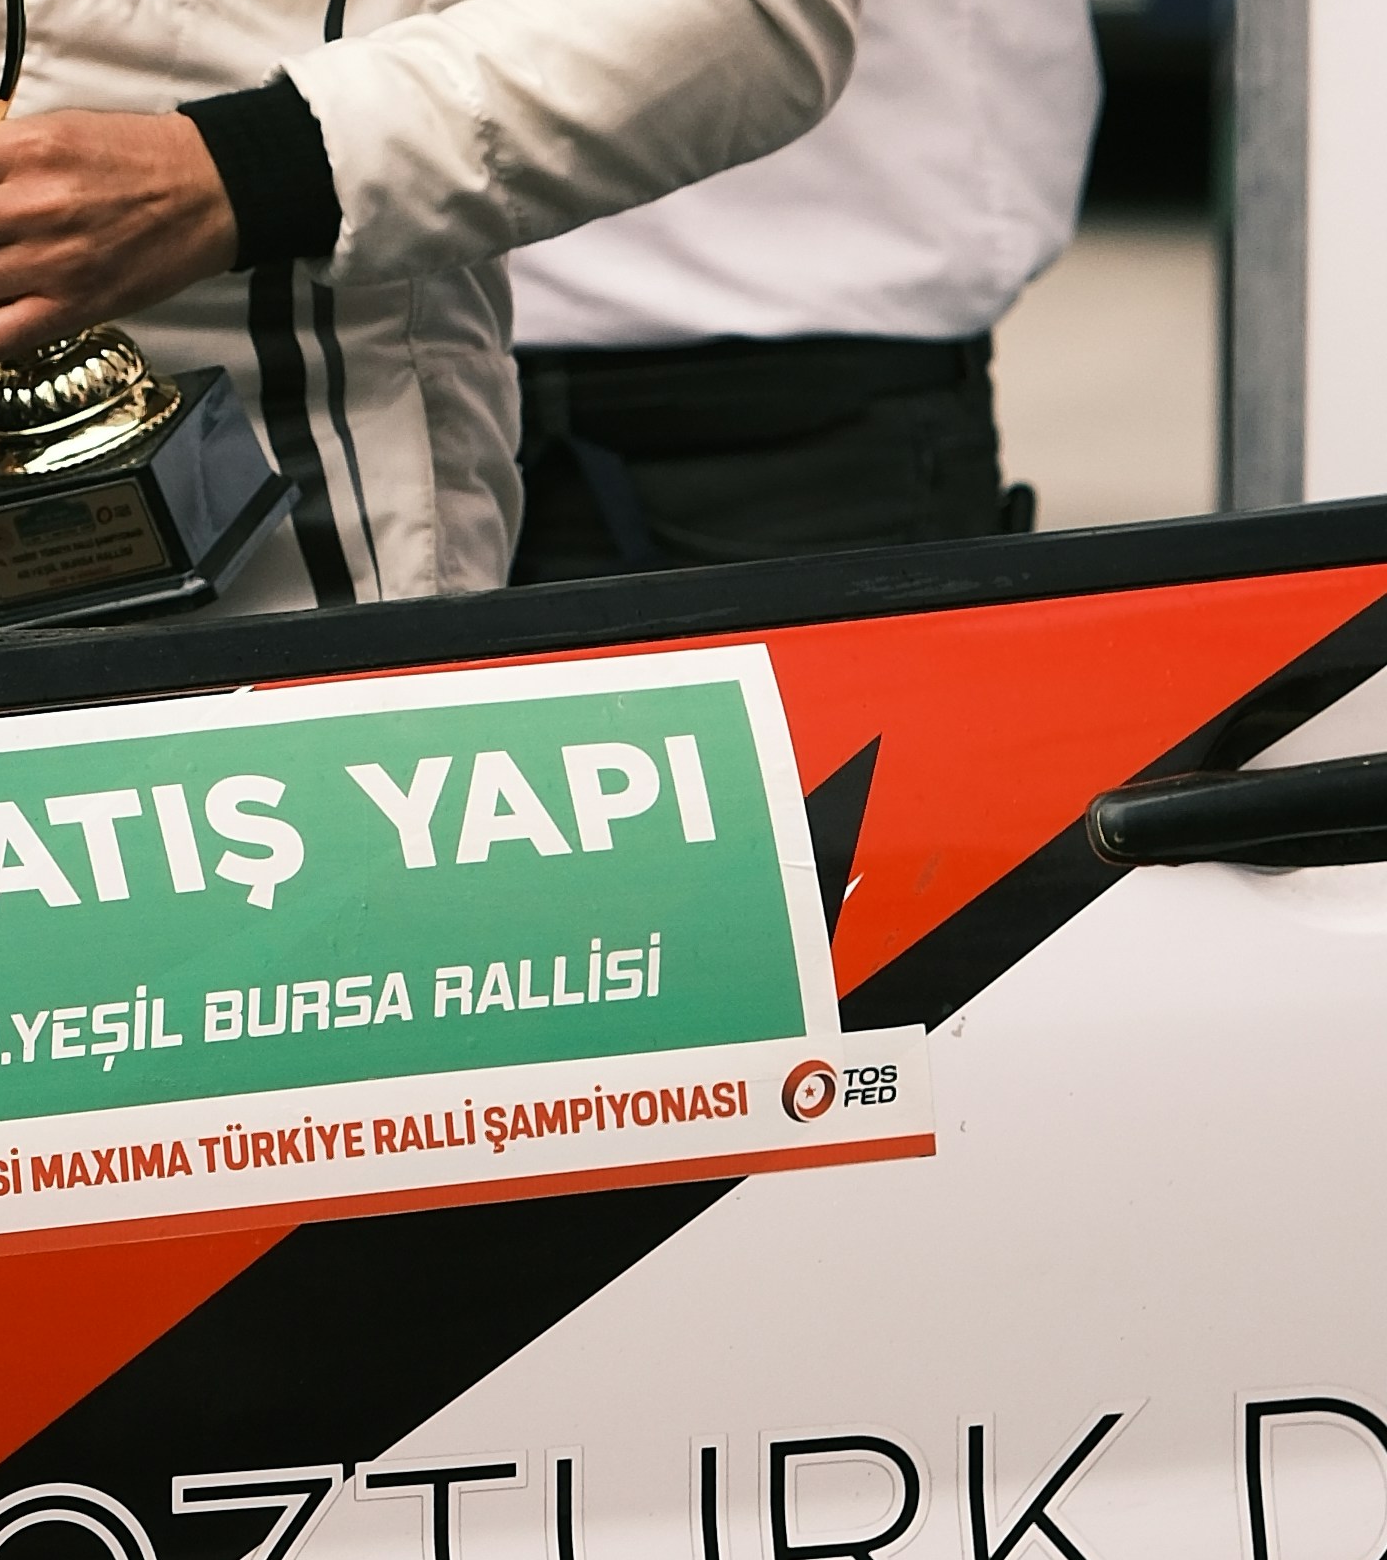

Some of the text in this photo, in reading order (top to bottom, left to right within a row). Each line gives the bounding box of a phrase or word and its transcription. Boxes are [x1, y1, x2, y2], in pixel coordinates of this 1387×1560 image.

[345, 734, 717, 870] YAPI
[203, 972, 414, 1044] BURSA
[433, 931, 661, 1019] RALLİSİ
[844, 1062, 898, 1087] TOS
[844, 1084, 898, 1109] FED
[30, 1140, 192, 1195] MAXIMA
[198, 1116, 365, 1173] TÜRKİYE
[372, 1100, 477, 1154] RALLİ
[484, 1080, 749, 1154] ŞAMPİYONASI
